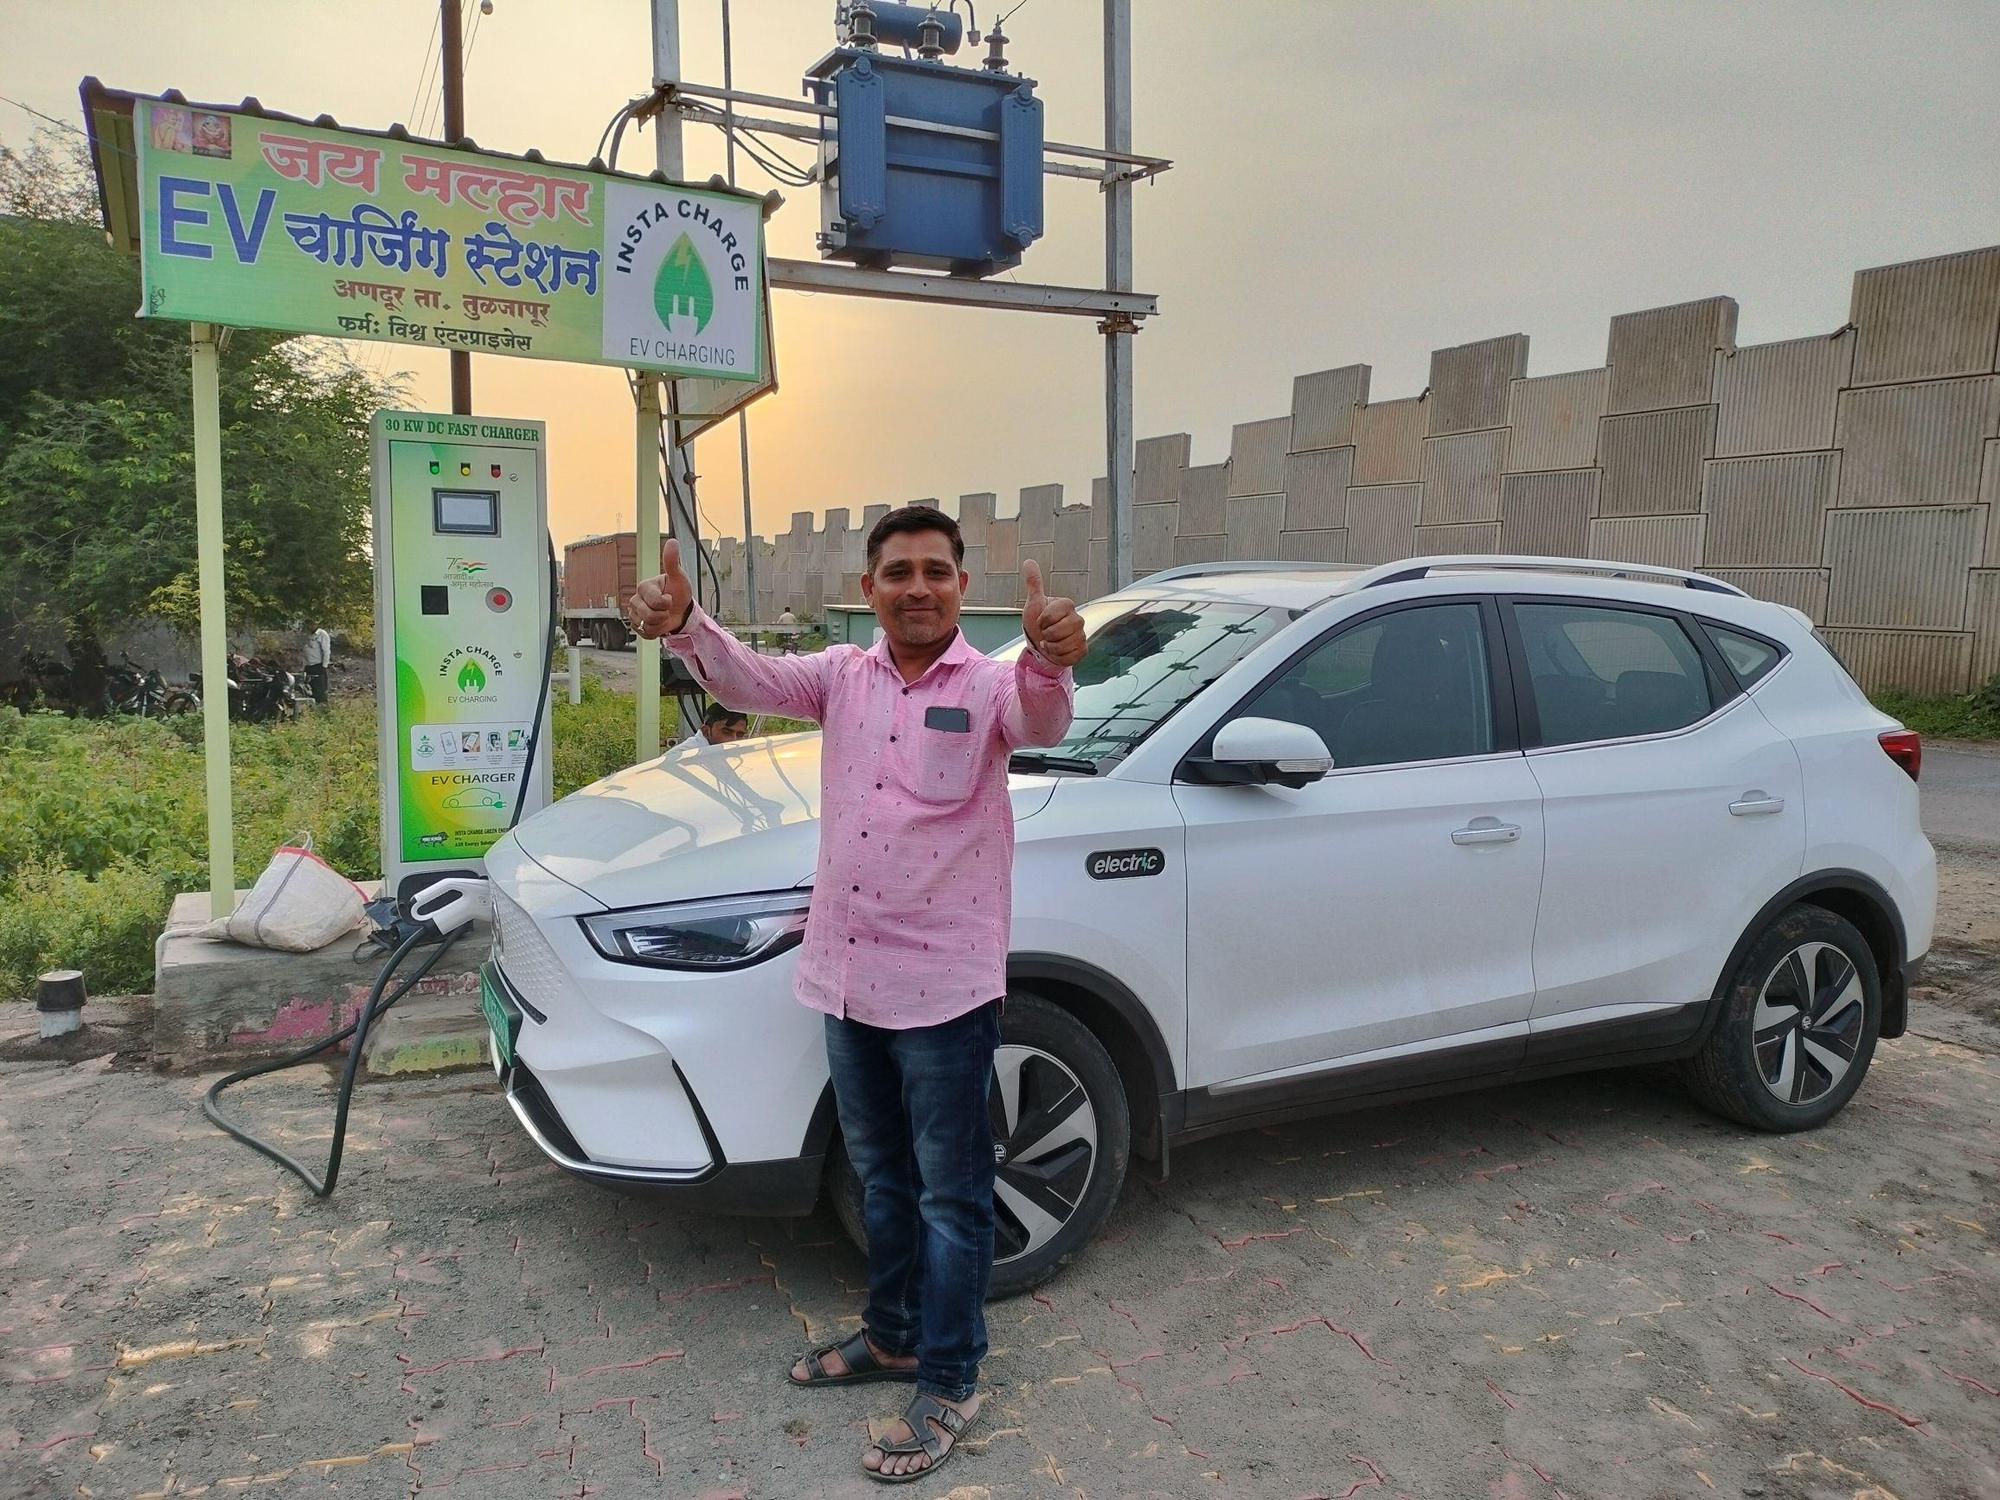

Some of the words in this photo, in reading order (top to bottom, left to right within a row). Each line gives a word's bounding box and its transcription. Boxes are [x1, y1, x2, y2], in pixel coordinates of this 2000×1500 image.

[258, 133, 382, 194] जय
[402, 154, 592, 226] मल्हार
[159, 175, 277, 264] EV
[284, 203, 450, 278] चार्जिंग
[464, 222, 600, 295] स्टेशन
[616, 202, 669, 274] INSTA
[677, 199, 749, 291] CHARGE
[332, 279, 406, 312] अणदूर
[462, 293, 550, 328] तुळजापूर
[388, 315, 428, 342] विश्व
[433, 321, 533, 351] एंटरप्राइजेस
[630, 337, 650, 357] EV
[655, 341, 735, 366] CHARGING
[385, 418, 400, 431] 30
[404, 419, 423, 433] KW
[427, 421, 445, 434] DC
[447, 422, 478, 437] FAST
[481, 425, 540, 442] CHARGER
[440, 648, 463, 677] INSTA
[466, 645, 503, 677] CHARGE
[459, 695, 498, 703] CHARGING
[431, 775, 450, 786] EV
[452, 772, 516, 785] CHARGER
[1094, 852, 1158, 873] electric
